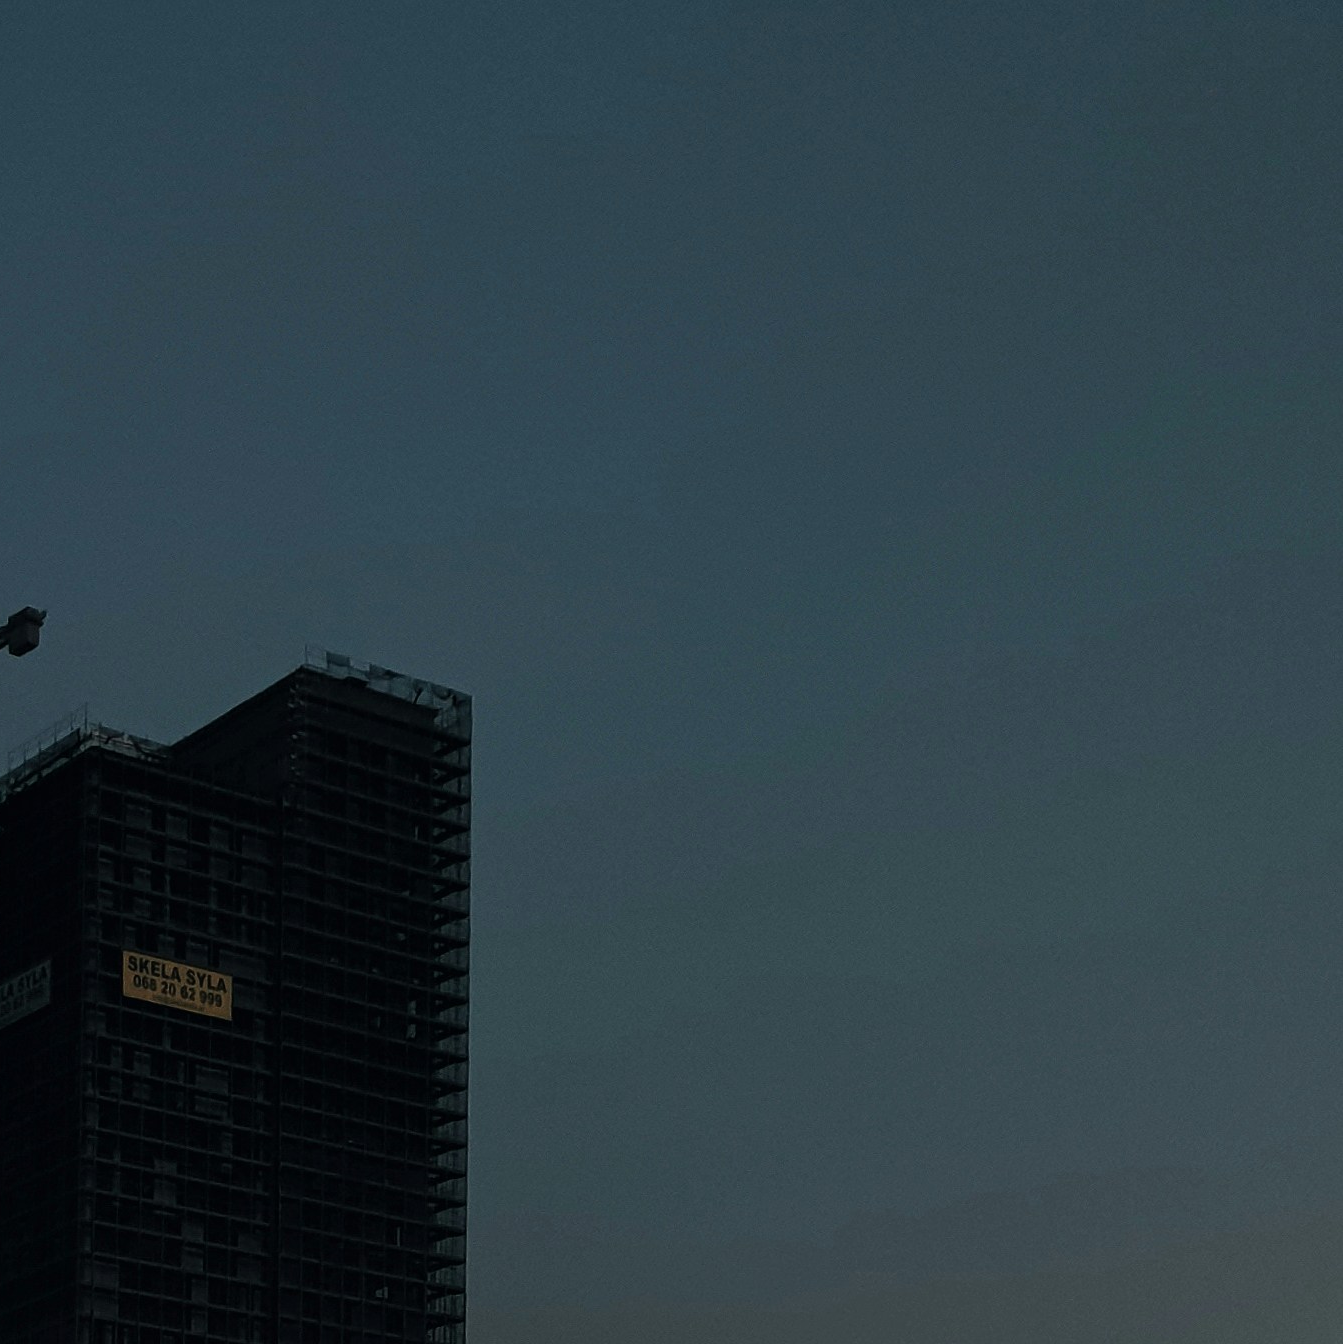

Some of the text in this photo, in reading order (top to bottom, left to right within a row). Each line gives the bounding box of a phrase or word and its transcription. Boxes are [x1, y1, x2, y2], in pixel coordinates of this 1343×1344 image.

[128, 955, 227, 994] SKELA SYLA
[161, 981, 176, 997] 20
